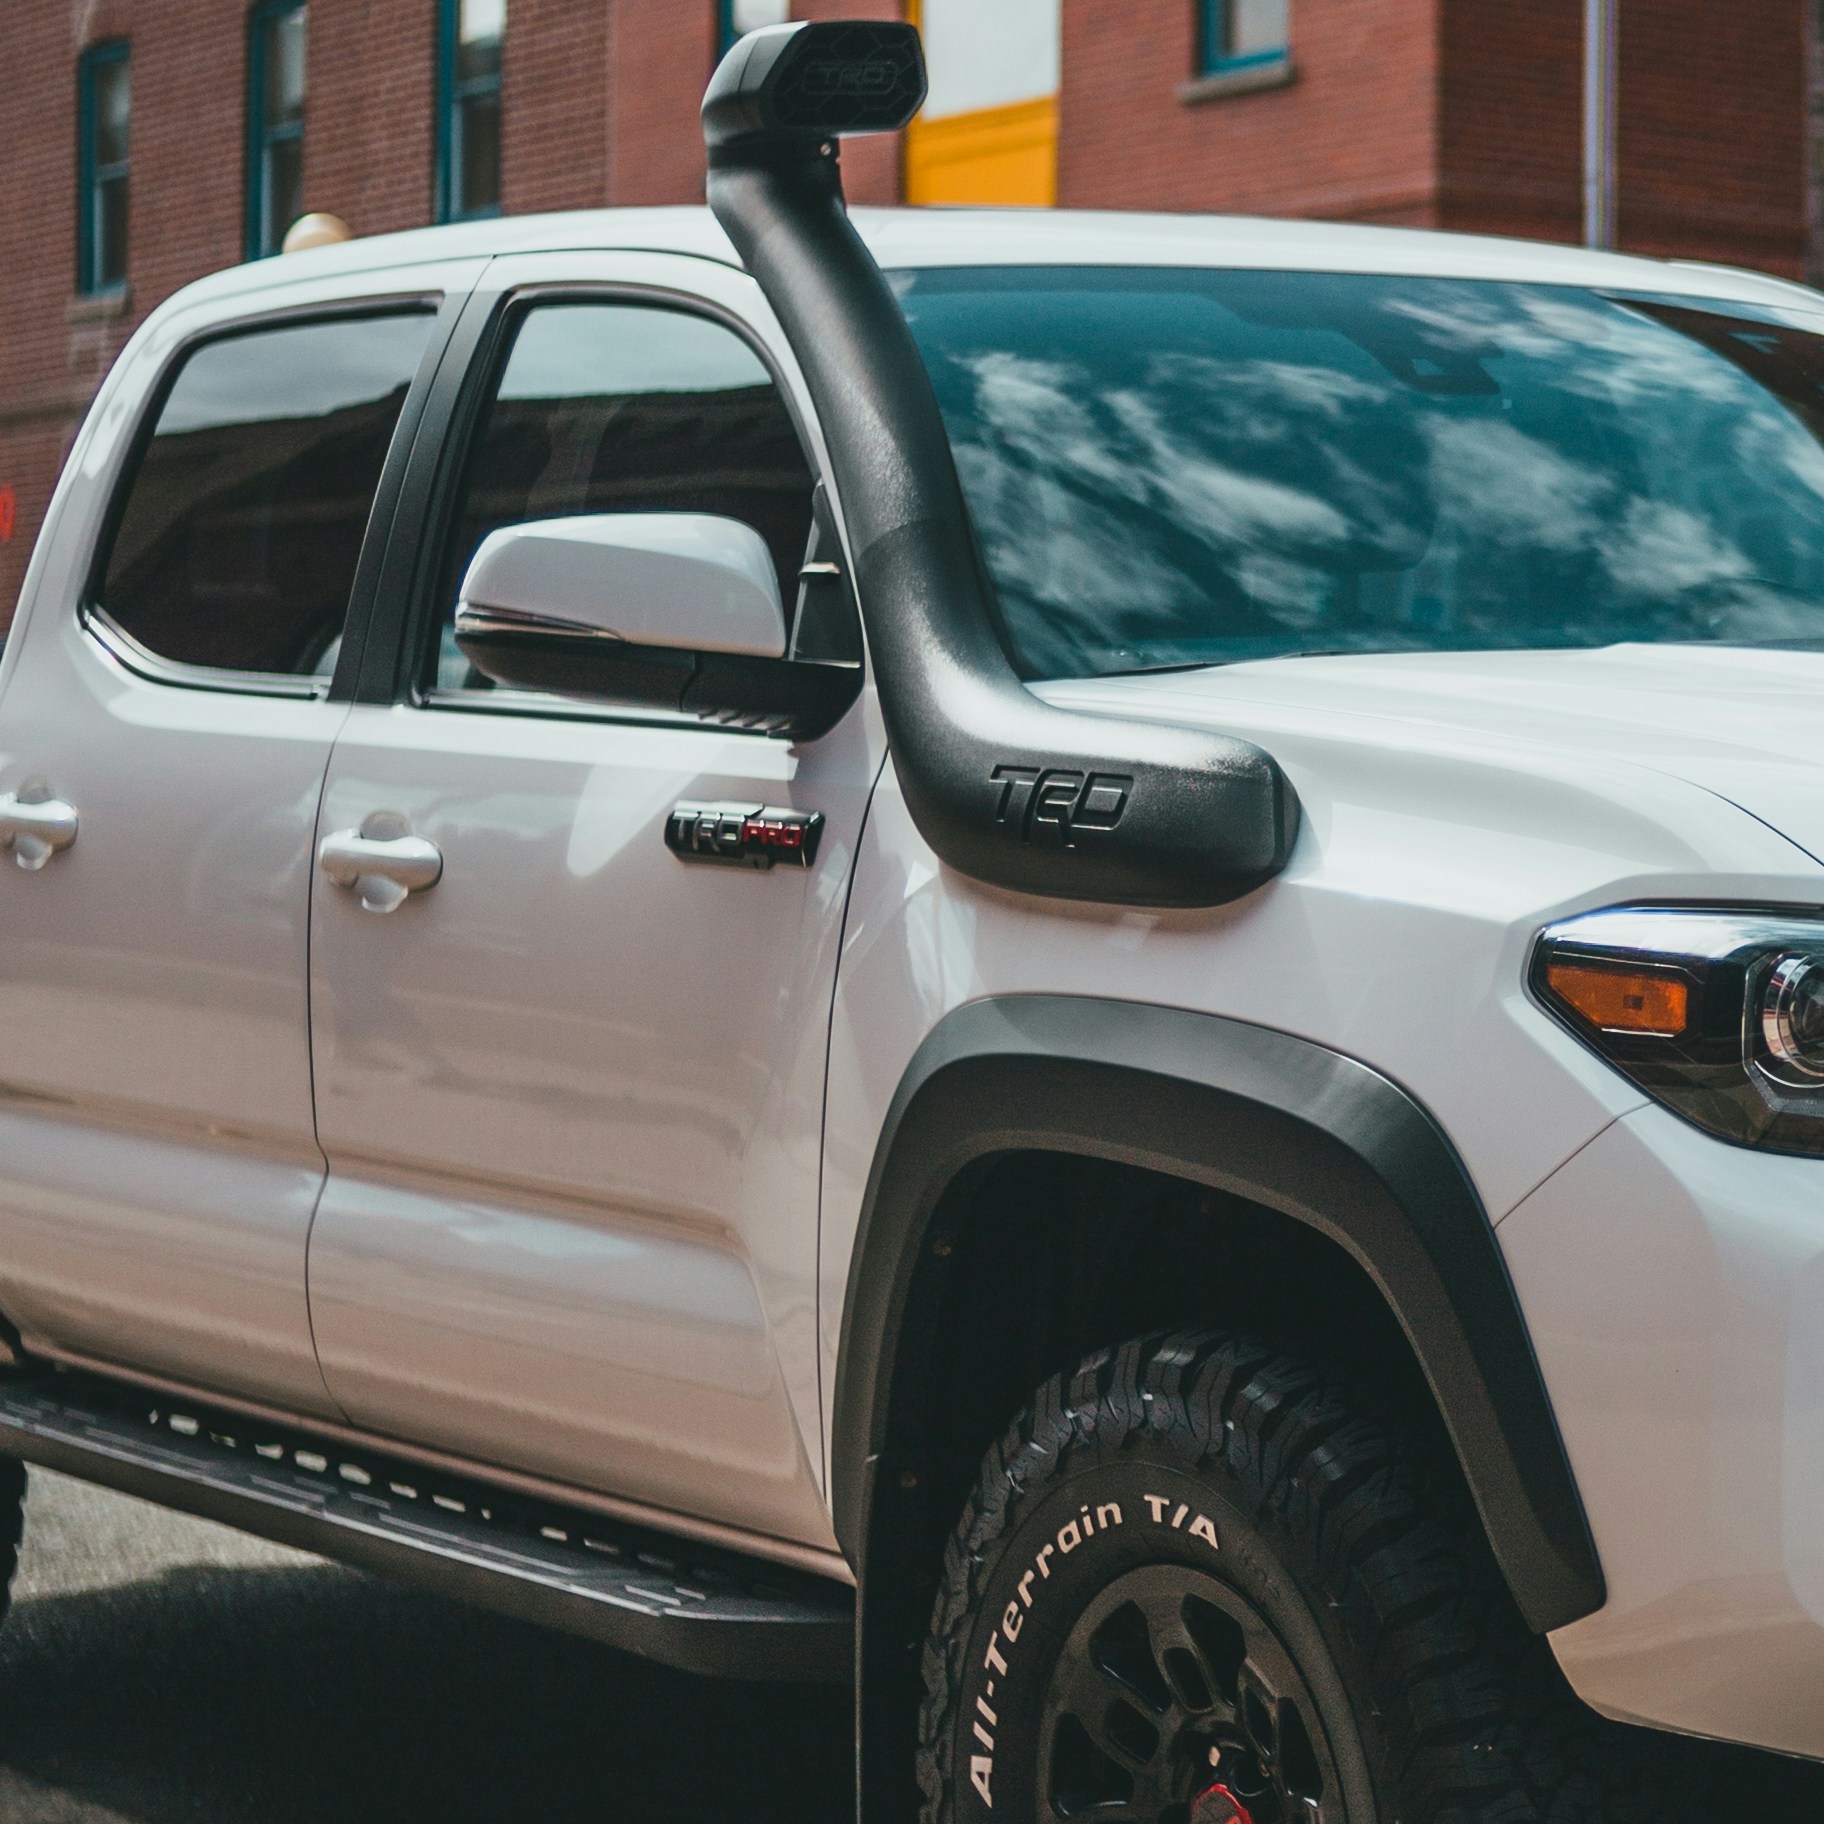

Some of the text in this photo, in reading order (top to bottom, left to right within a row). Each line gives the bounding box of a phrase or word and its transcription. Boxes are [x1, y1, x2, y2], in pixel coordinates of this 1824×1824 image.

[672, 810, 802, 853] TRD PRO
[988, 763, 1135, 849] TRD
[970, 1493, 1219, 1808] All-Terrain T/A
